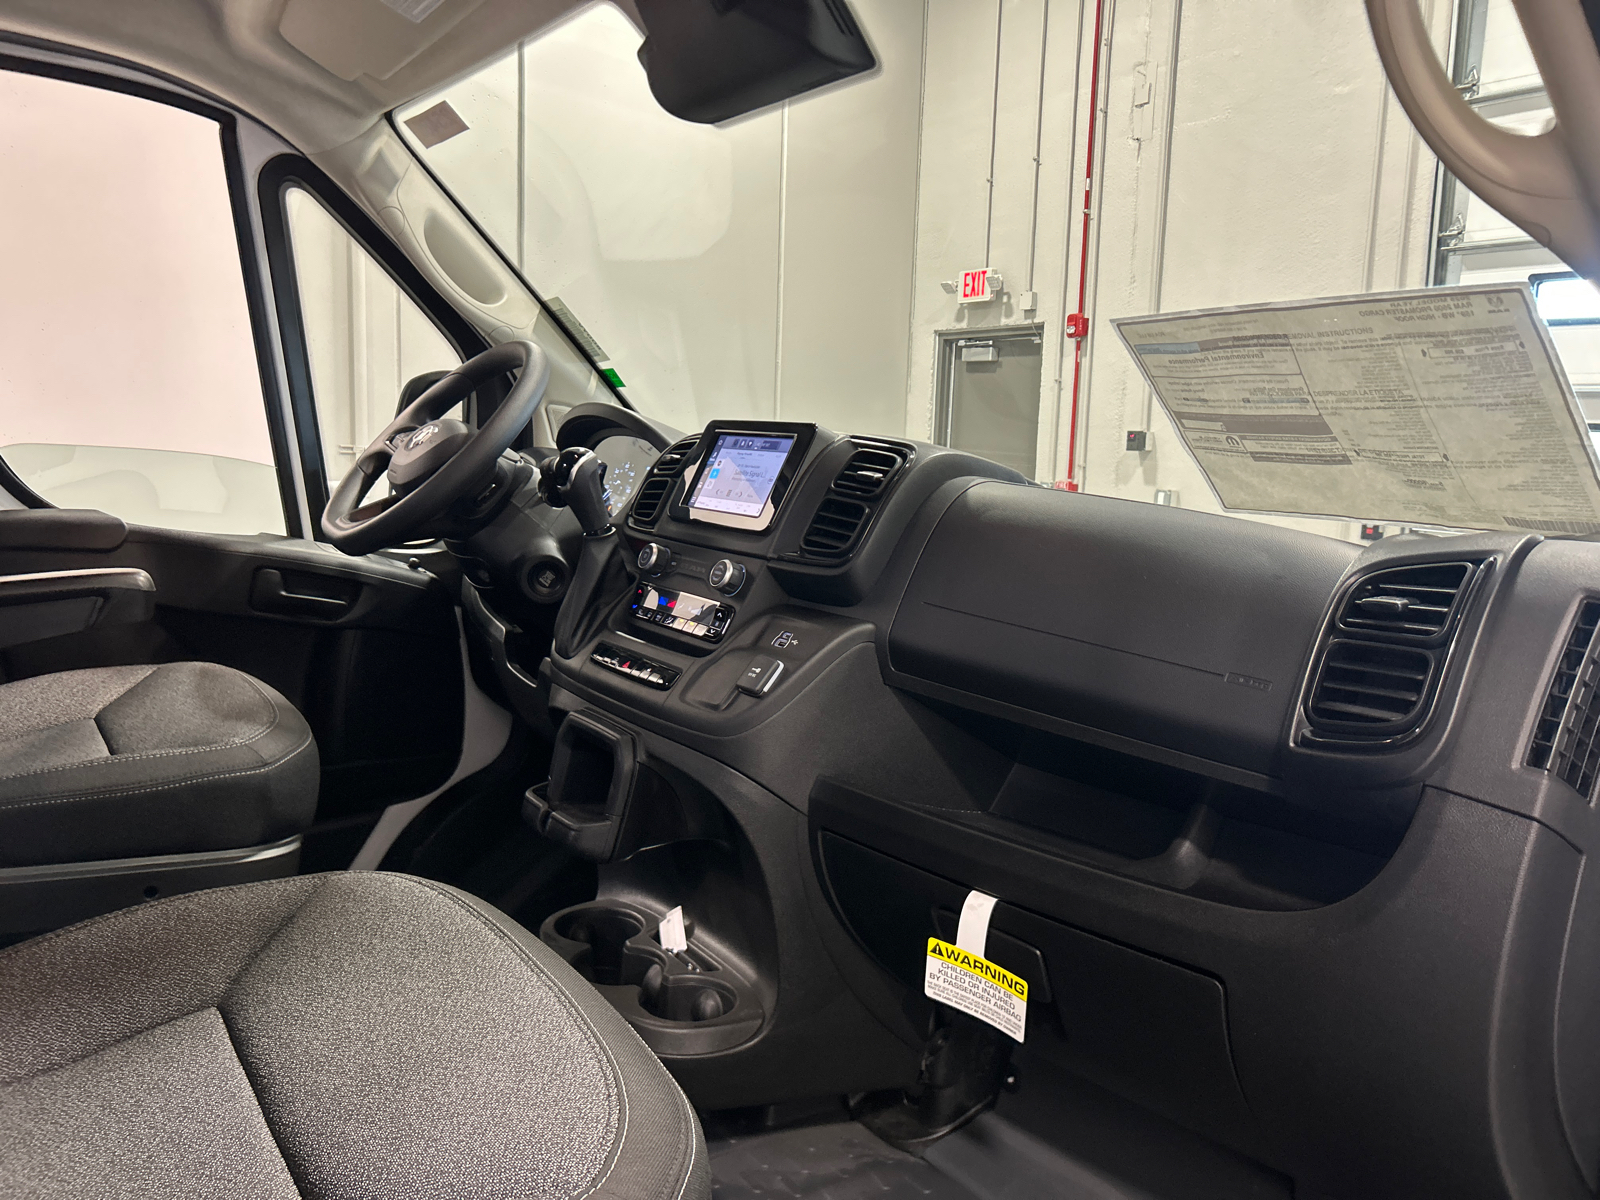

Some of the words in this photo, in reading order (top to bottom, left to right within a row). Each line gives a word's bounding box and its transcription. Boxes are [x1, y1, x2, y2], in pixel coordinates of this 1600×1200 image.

[963, 270, 987, 298] EXIT
[1317, 327, 1373, 338] INSTRUCTIONS
[938, 968, 965, 984] KILLED
[968, 980, 980, 991] OR
[982, 986, 1016, 1010] INJURED
[941, 962, 982, 984] CHILDREN
[984, 980, 1001, 994] CAN
[1003, 990, 1014, 1001] BE
[945, 947, 1025, 996] WARNING
[930, 972, 941, 981] BY
[943, 977, 992, 1005] PASSENGER
[993, 1001, 1022, 1022] AIRBAG
